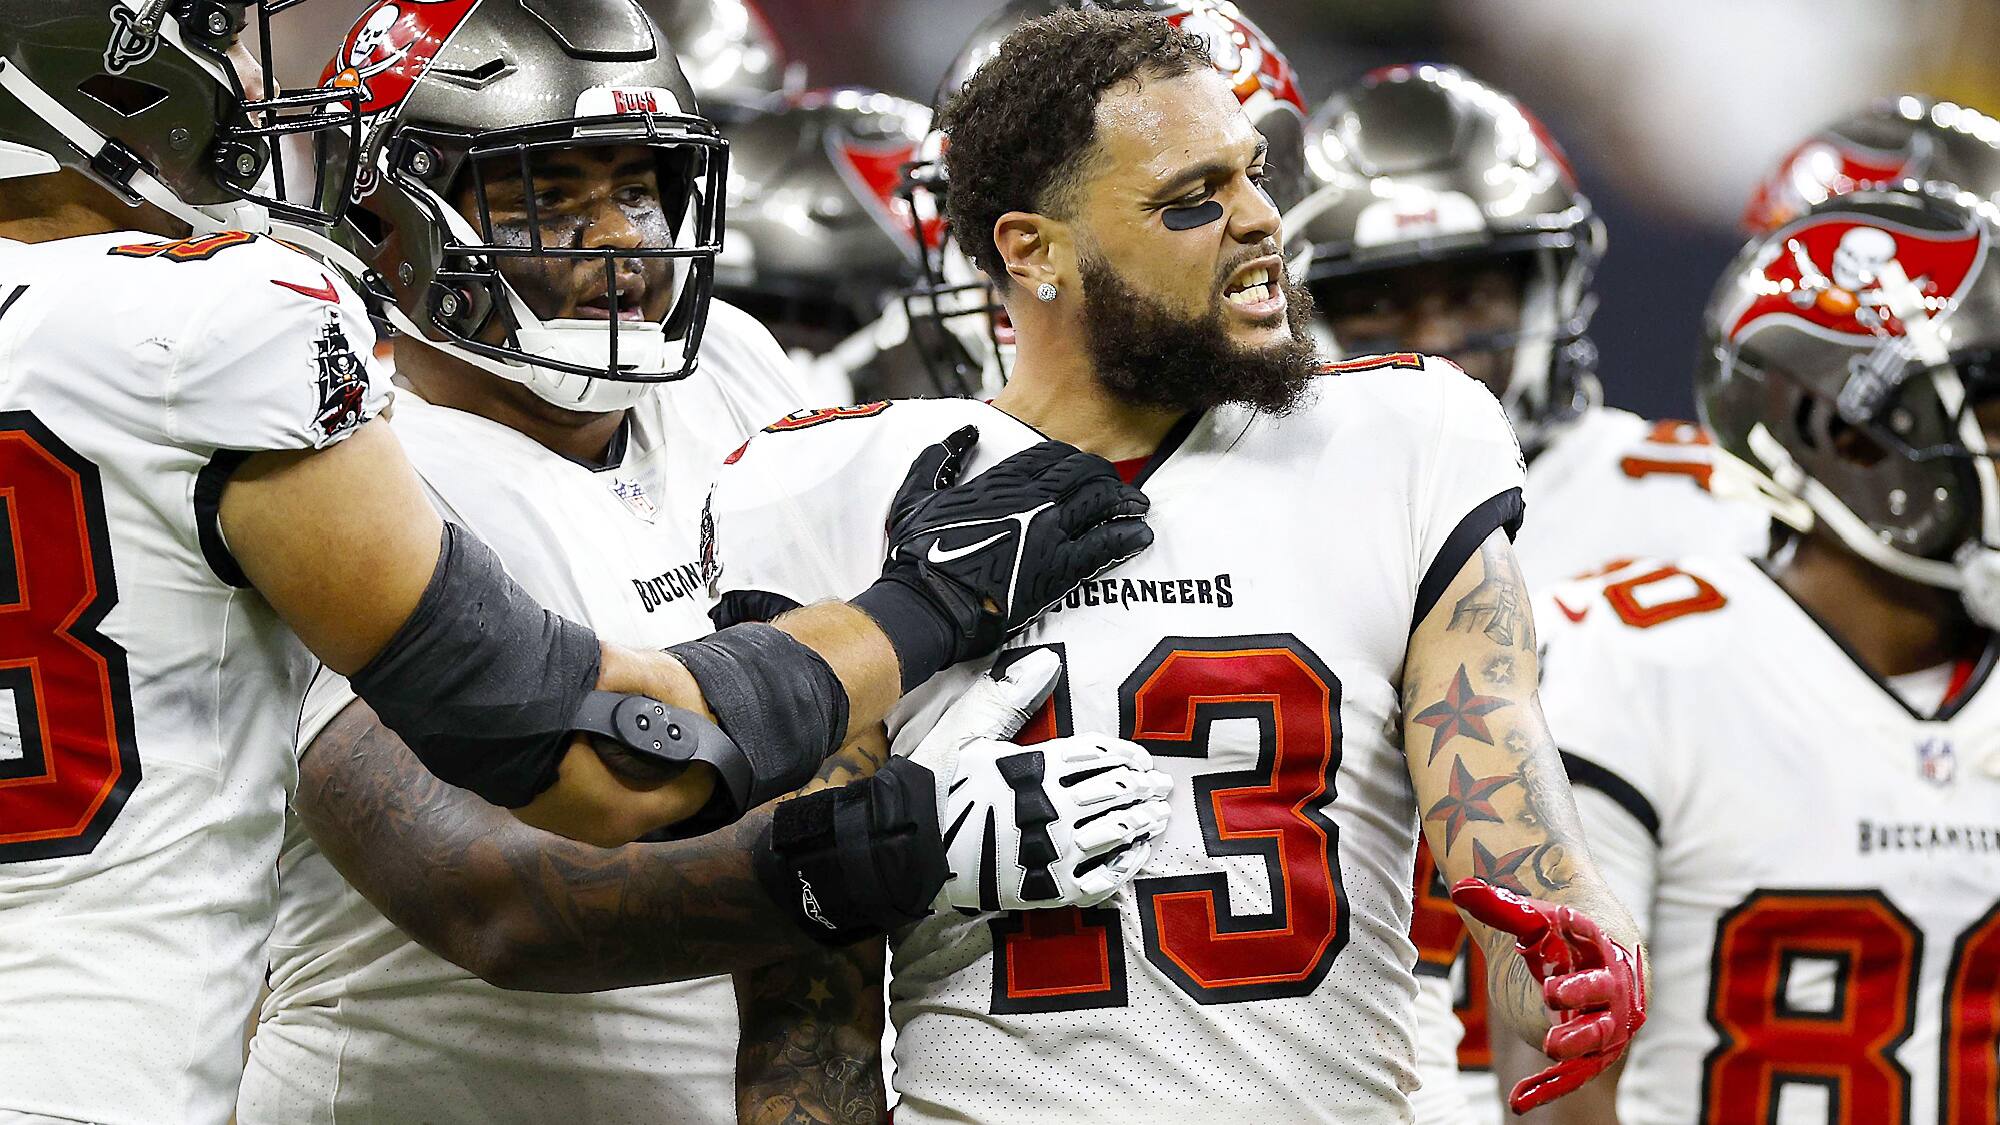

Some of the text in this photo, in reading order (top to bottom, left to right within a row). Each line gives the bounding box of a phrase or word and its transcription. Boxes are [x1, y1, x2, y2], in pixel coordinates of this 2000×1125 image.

[630, 561, 703, 613] BUCCAN
[1049, 573, 1234, 613] UCCANEERS
[988, 633, 1351, 1016] 13
[1858, 818, 2000, 856] BUCCANEE
[1695, 887, 2000, 1125] 8
